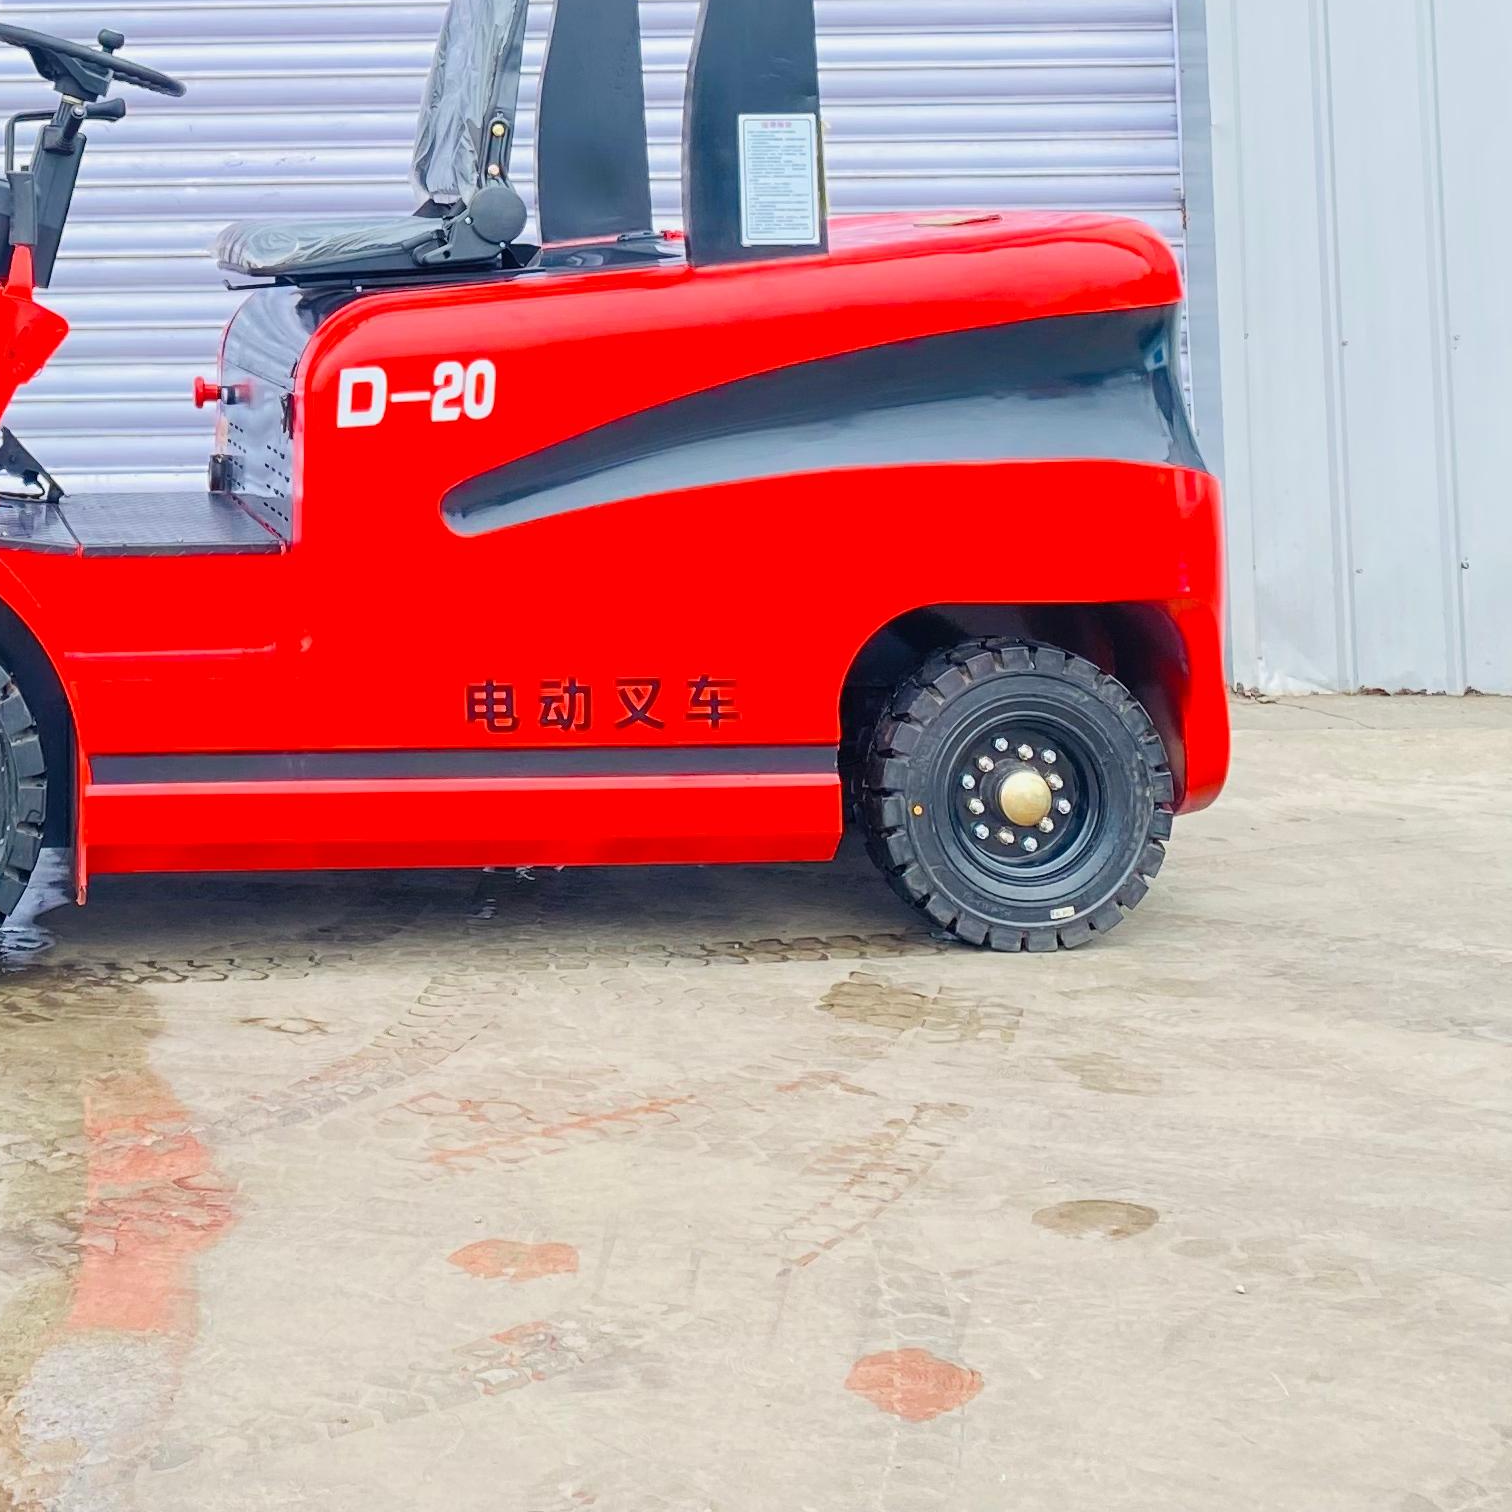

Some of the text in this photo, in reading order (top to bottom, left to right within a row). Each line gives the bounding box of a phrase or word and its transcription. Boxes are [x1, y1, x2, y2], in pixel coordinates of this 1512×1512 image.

[336, 359, 497, 429] D-20
[464, 673, 740, 733] 电动叉车
